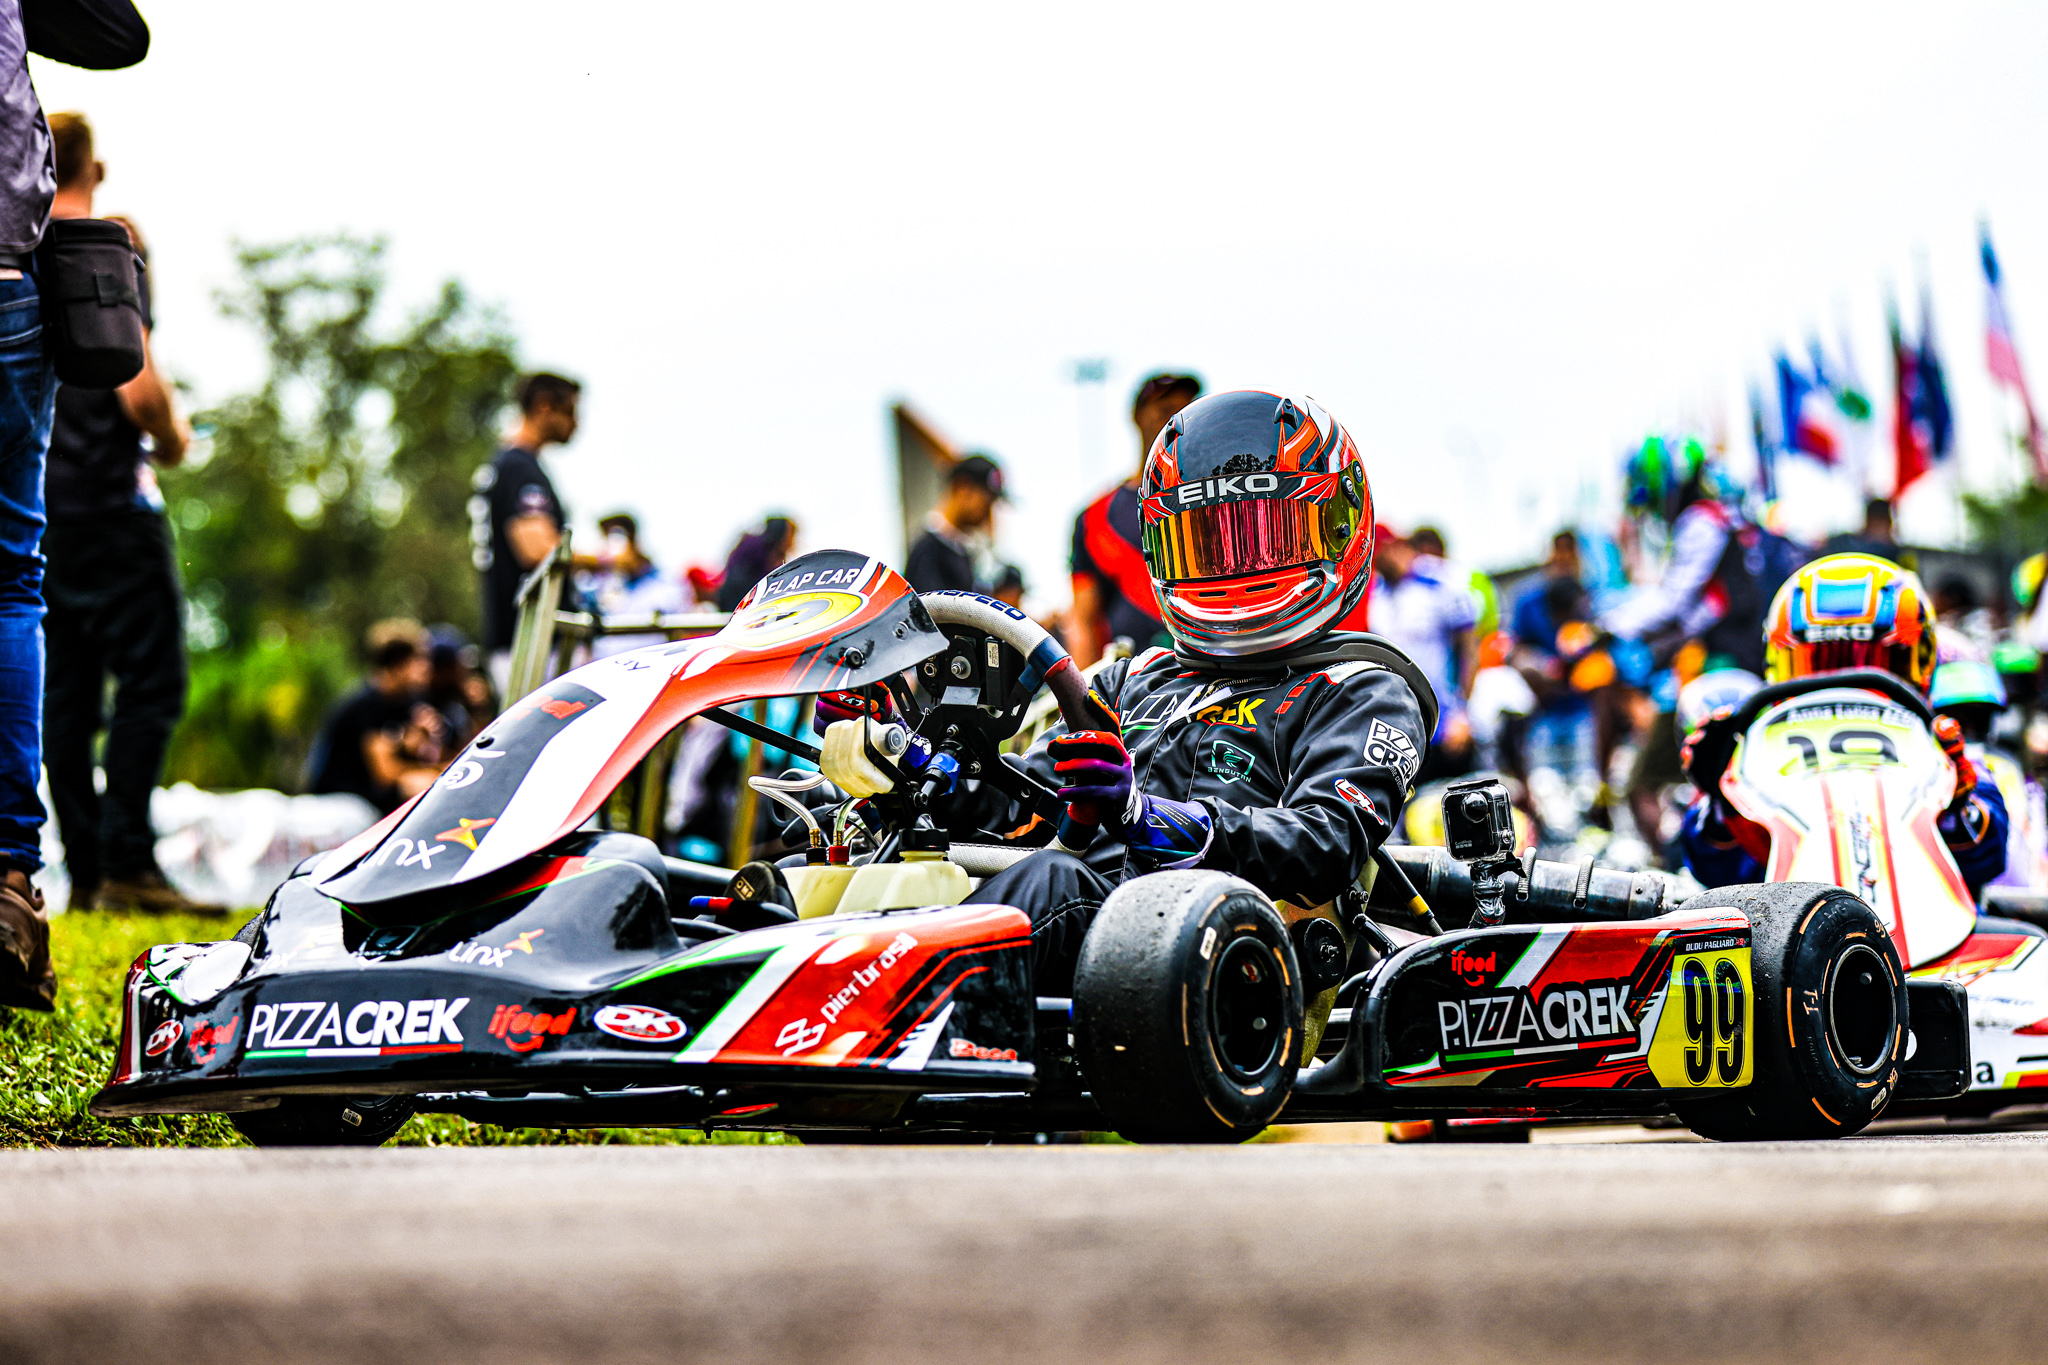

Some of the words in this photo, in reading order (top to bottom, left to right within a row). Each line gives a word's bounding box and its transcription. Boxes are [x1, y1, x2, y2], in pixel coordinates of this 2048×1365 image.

[1178, 473, 1278, 505] EIKO
[763, 572, 815, 599] FLAP
[815, 568, 861, 586] CAR
[1704, 939, 1735, 949] PAGLIARO
[820, 931, 918, 1024] pierbrasil
[1451, 951, 1496, 976] ifood
[246, 997, 471, 1049] PIZZACREK
[487, 1003, 578, 1039] ifood
[602, 1005, 681, 1034] DK
[1438, 984, 1636, 1050] PIZZACREK
[1681, 956, 1747, 1087] 99
